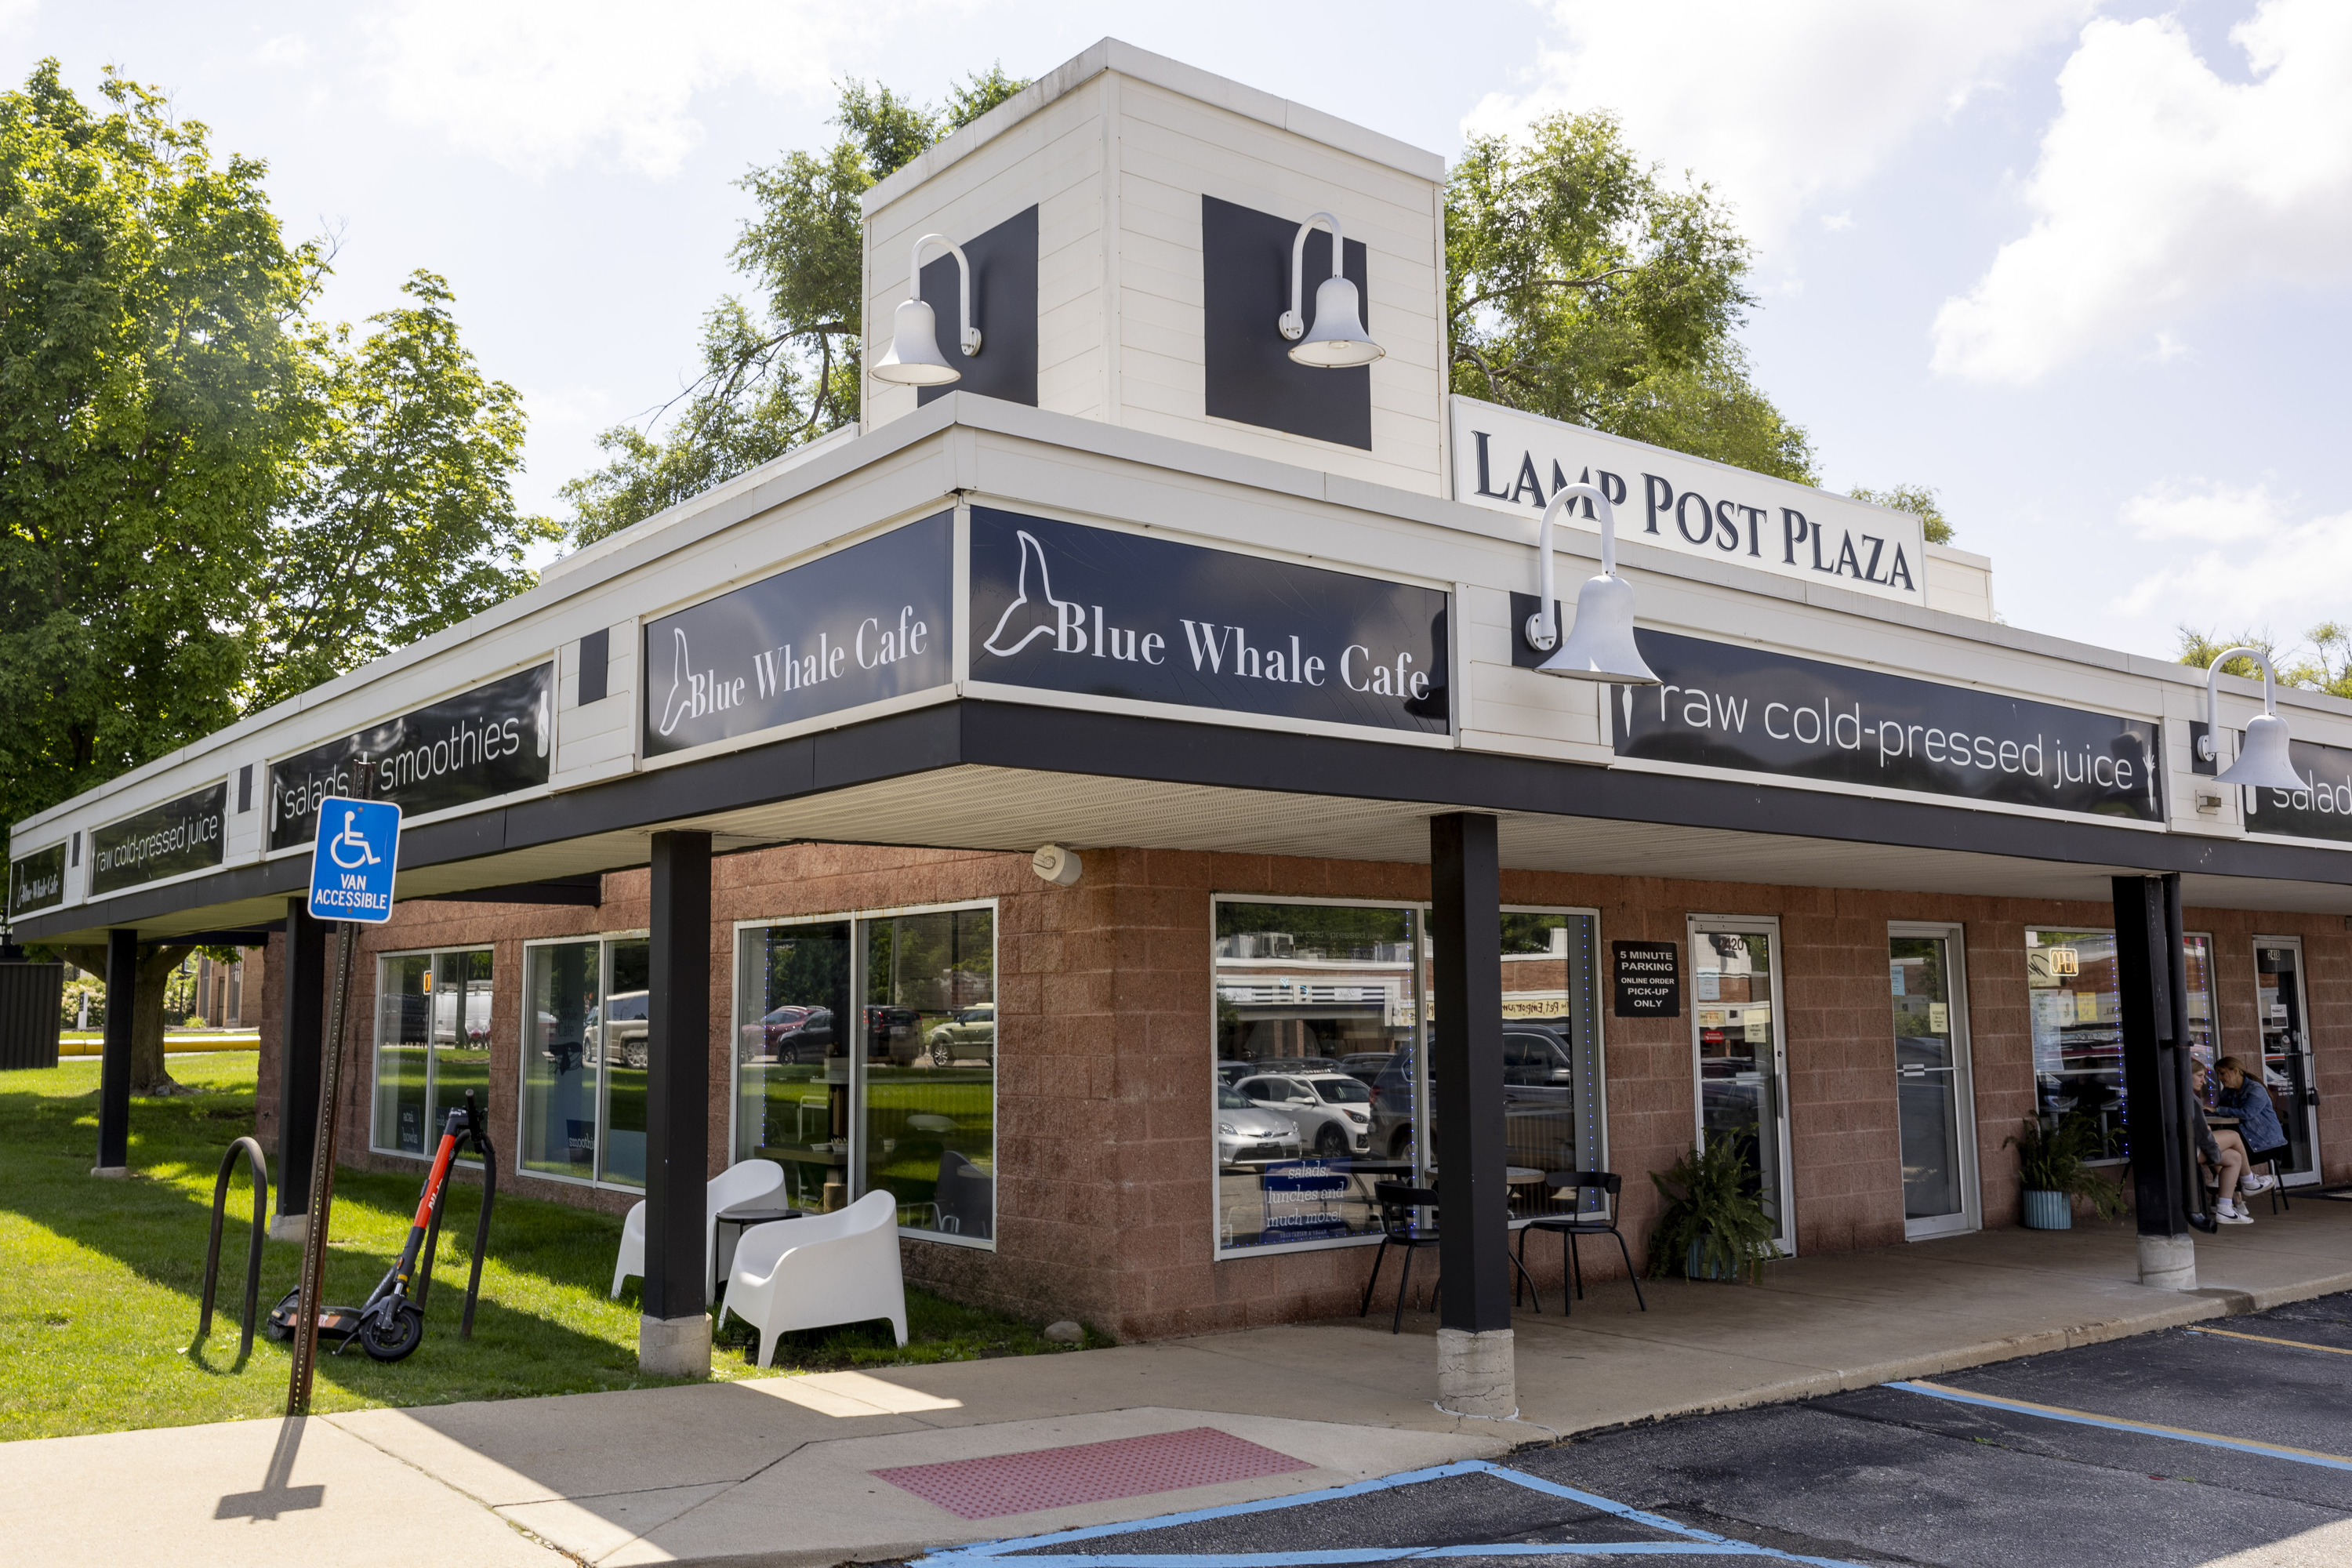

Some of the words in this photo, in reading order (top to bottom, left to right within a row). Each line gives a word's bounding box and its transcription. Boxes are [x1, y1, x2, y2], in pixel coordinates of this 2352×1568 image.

[1471, 430, 1628, 521] LAMP
[1641, 472, 1768, 557] POST
[1779, 506, 1917, 592] PLAZA
[690, 668, 746, 720] Blue
[753, 632, 845, 700] Whale
[855, 604, 927, 670] Cafe
[1052, 601, 1166, 666] Blue
[1179, 619, 1326, 687] Whale
[1340, 644, 1430, 701] Cafe
[1660, 684, 1748, 734] raw
[1764, 697, 2043, 776] cold-pressed
[2053, 739, 2132, 789] juice
[285, 764, 349, 819] salads
[380, 717, 520, 791] smoothies
[96, 849, 113, 873] raw
[114, 816, 186, 869] cold-pressed
[186, 812, 218, 854] juice
[340, 873, 367, 891] VAN
[314, 888, 388, 909] ACCESSIBLE
[1621, 962, 1673, 971] PARKING
[1630, 951, 1673, 960] MINUTE
[2051, 951, 2077, 973] OPEN
[1267, 1184, 1318, 1204] lunches
[1320, 1181, 1345, 1200] and
[1266, 1207, 1303, 1228] much
[1305, 1203, 1342, 1224] more!
